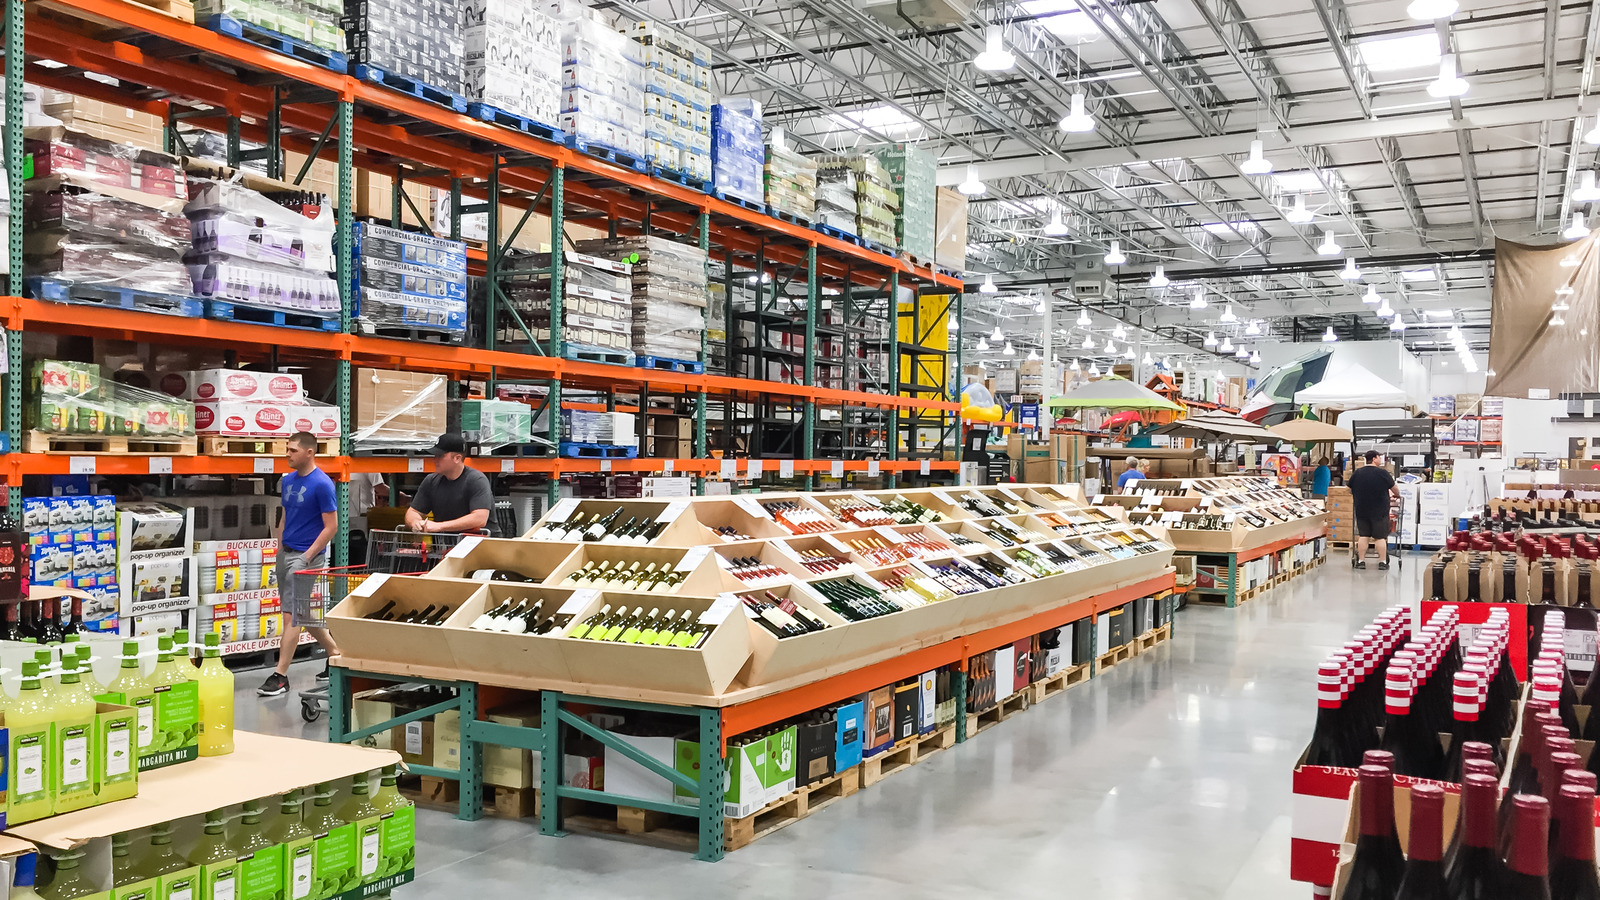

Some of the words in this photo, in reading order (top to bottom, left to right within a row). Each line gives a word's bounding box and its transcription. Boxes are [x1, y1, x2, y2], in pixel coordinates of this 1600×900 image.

[374, 228, 431, 244] COMMERCIAL-GRADE
[432, 238, 458, 249] SHELVING
[374, 259, 431, 274] COMMERCIAL-GRADE
[272, 380, 293, 389] Shiner
[147, 411, 168, 424] XX
[260, 411, 281, 420] Shiner
[227, 541, 258, 550] BUCKLE
[260, 540, 271, 548] UP
[130, 552, 153, 560] pop-up
[155, 550, 185, 558] organizer
[228, 592, 258, 602] BUCKLE
[260, 590, 271, 598] UP
[132, 603, 156, 613] pop-up
[158, 599, 190, 608] organizer
[225, 642, 256, 653] BUCKLE
[258, 640, 269, 648] UP
[176, 750, 187, 759] MIX
[363, 878, 393, 896] MARGARITA
[395, 874, 405, 885] MIX
